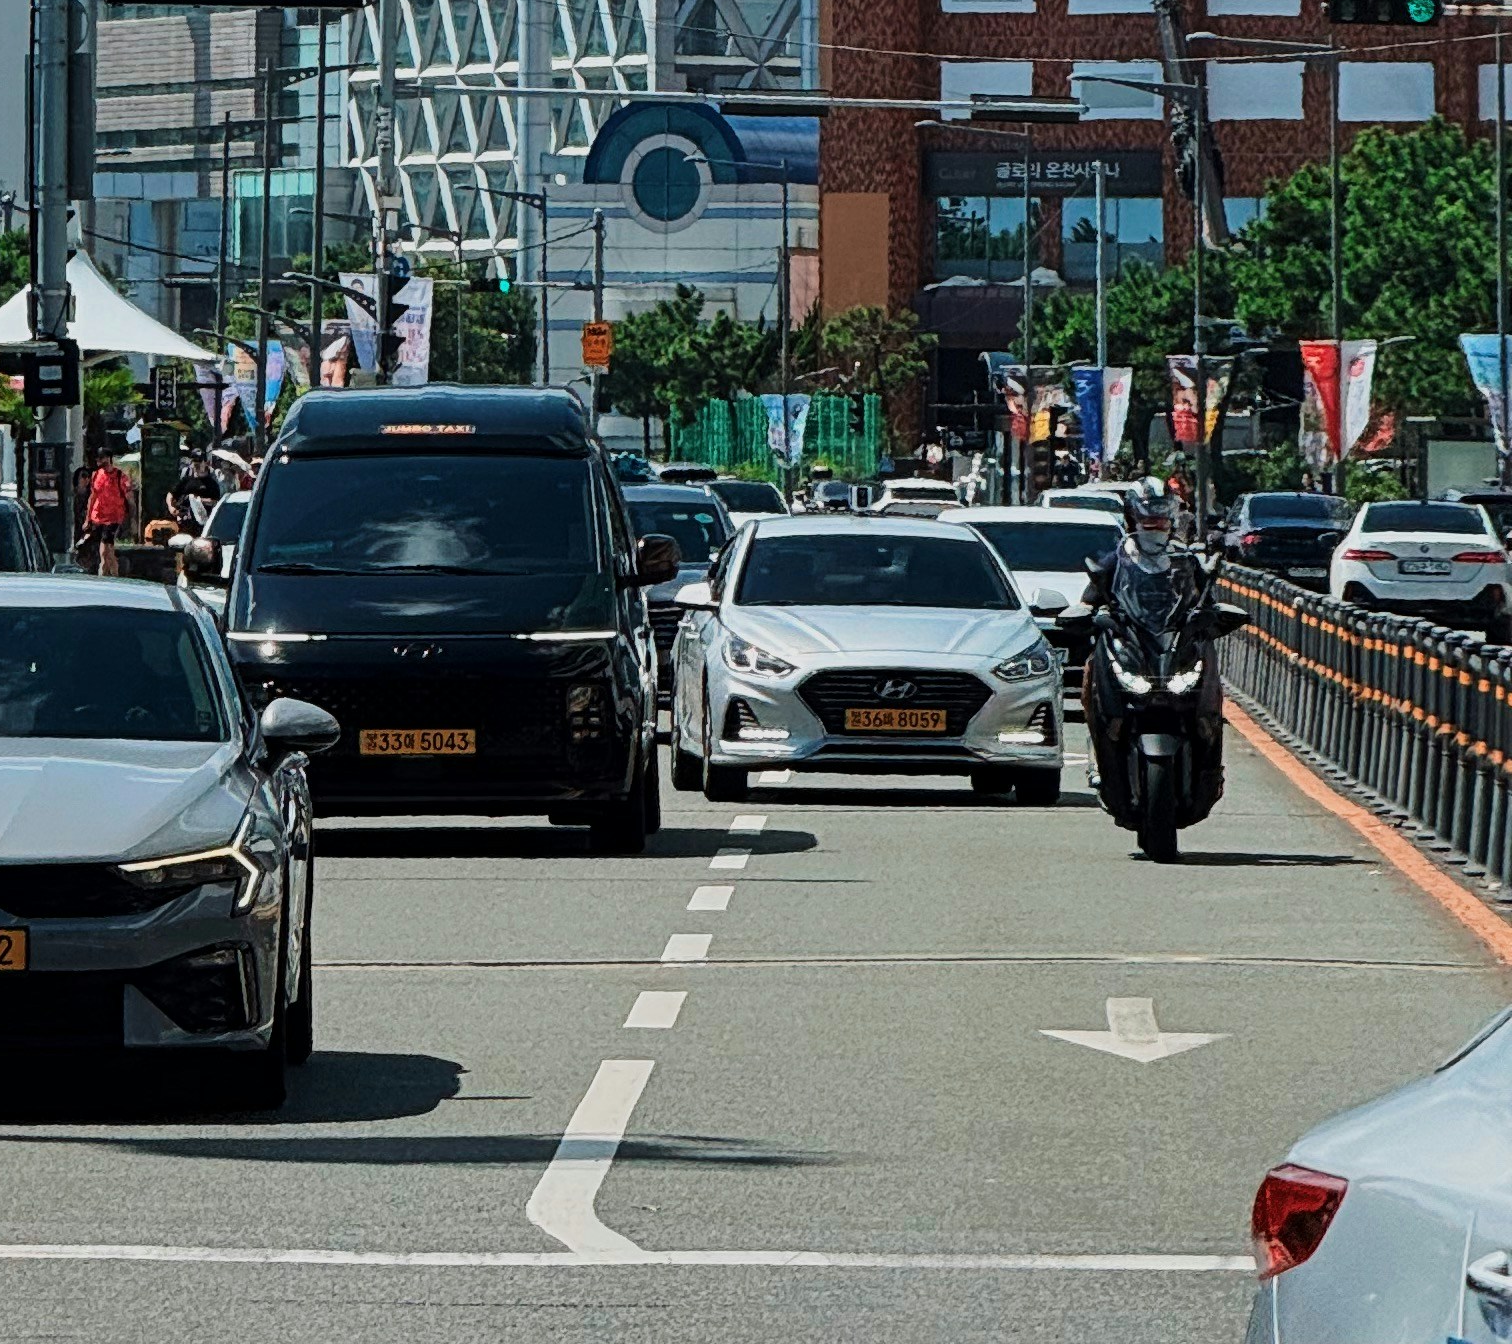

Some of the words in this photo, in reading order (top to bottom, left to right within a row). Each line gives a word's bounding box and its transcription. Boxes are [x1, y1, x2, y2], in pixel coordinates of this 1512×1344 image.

[436, 424, 476, 434] TAXI
[898, 712, 941, 728] 8059
[420, 732, 469, 751] 5043
